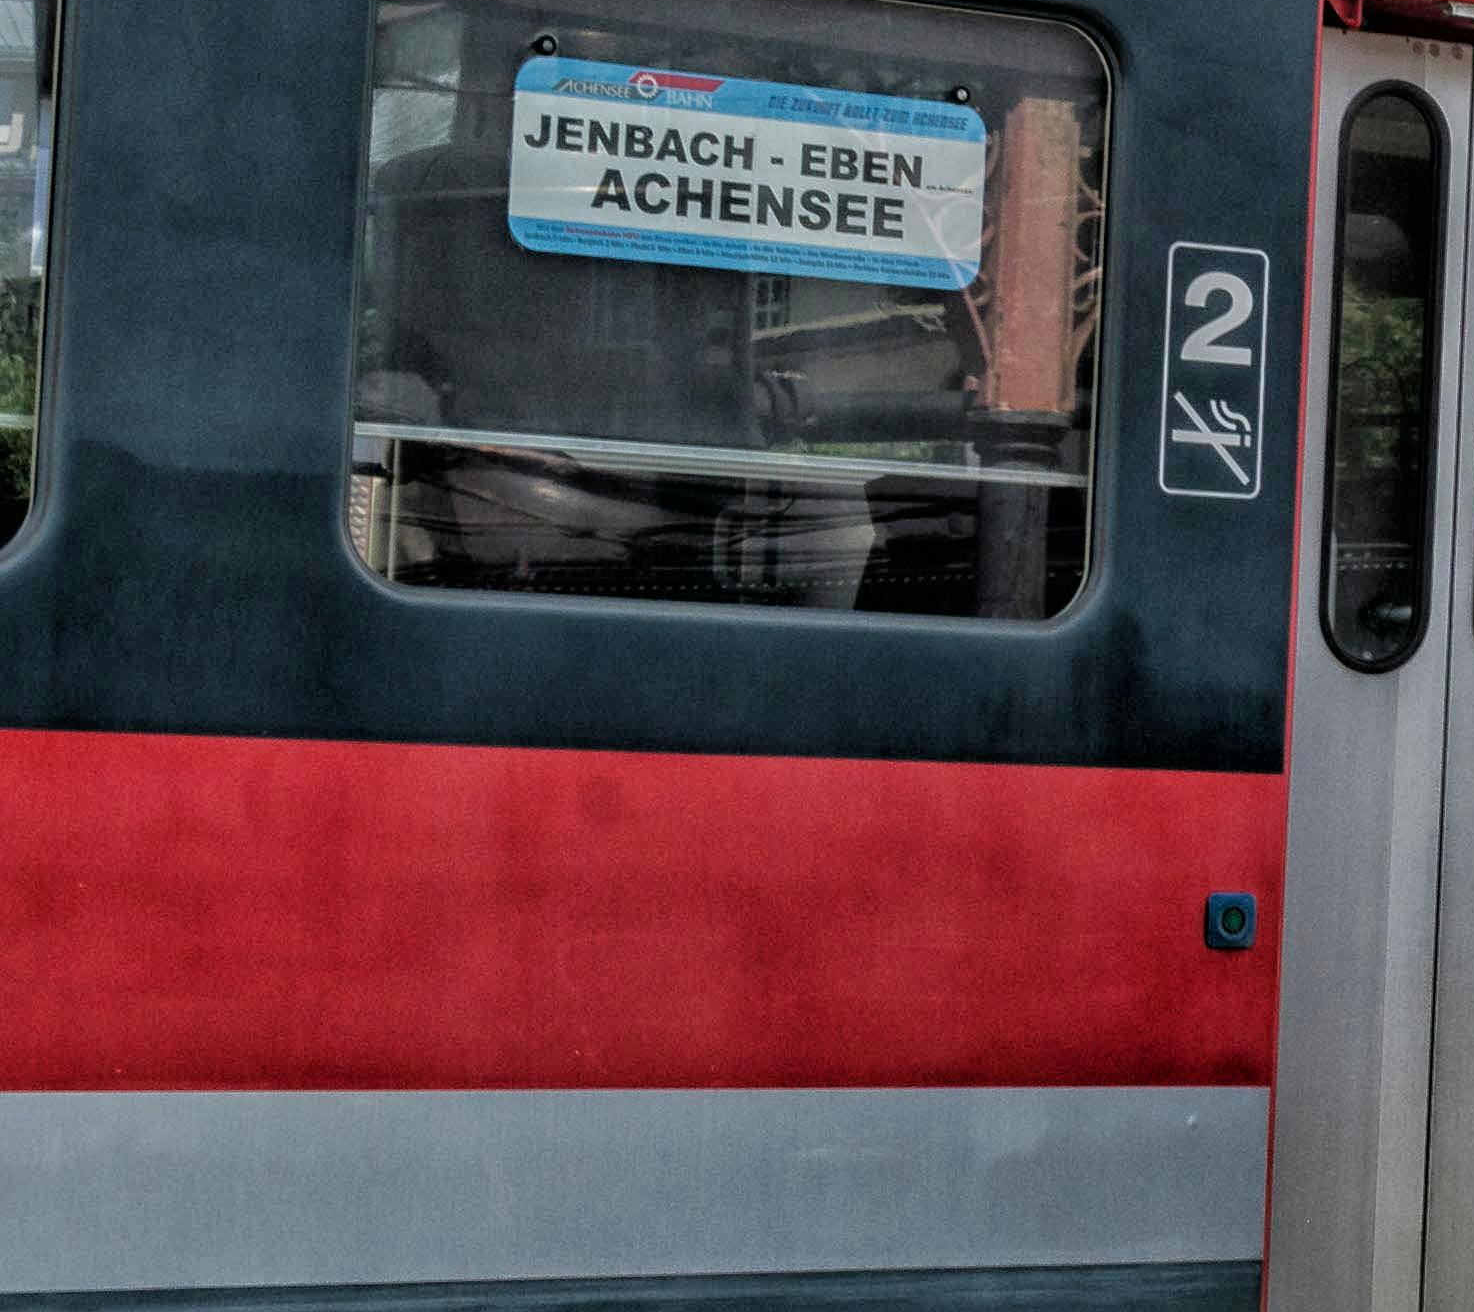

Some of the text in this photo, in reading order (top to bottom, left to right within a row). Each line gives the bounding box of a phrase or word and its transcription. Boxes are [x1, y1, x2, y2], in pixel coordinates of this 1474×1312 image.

[555, 79, 713, 109] ACHENSEE BAHN
[523, 114, 755, 170] JENBACH
[801, 143, 923, 189] EBEN
[591, 169, 904, 239] ACHENSEE
[1181, 270, 1253, 367] 2
